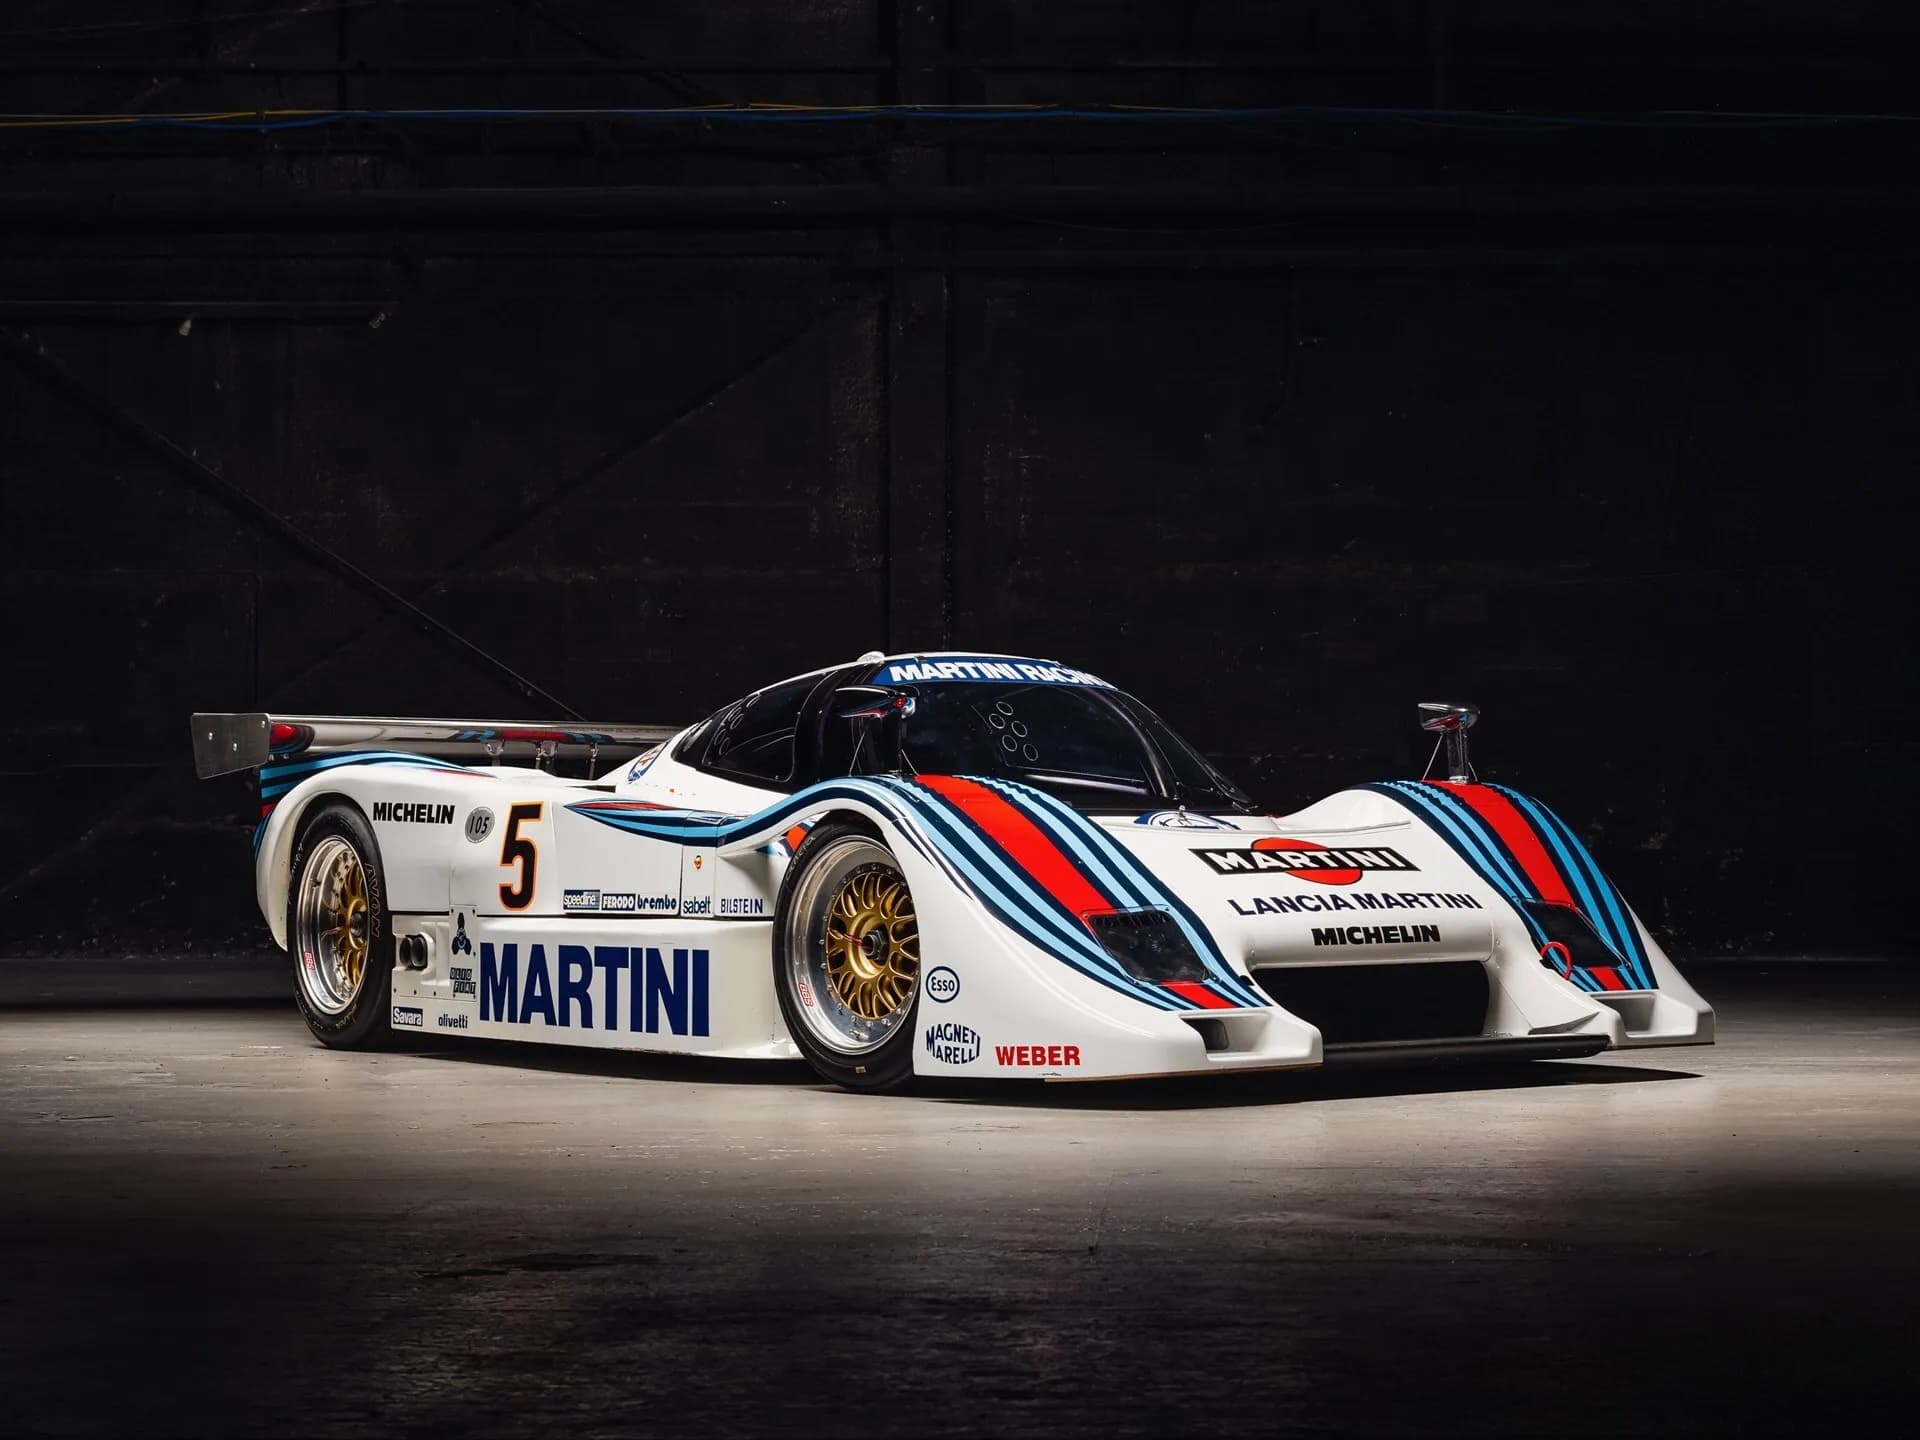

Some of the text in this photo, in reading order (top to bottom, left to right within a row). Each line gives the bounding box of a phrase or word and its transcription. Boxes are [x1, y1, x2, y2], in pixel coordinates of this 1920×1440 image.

[889, 662, 1117, 690] MARTINI RACIN
[373, 802, 455, 824] MICHELIN
[469, 815, 490, 834] 105
[499, 801, 544, 912] 5
[1205, 849, 1407, 871] MARTINI
[364, 862, 380, 938] AVON
[602, 895, 635, 909] FERODO
[637, 894, 677, 910] brembo
[683, 897, 711, 914] sabelt
[720, 898, 763, 914] BILSTEIN
[1228, 892, 1483, 916] LANCIA MARTINI
[1311, 925, 1441, 946] MICHELIN
[453, 981, 476, 994] FIAT
[479, 942, 710, 1037] MARTINI
[393, 1007, 423, 1026] Savara
[438, 1013, 468, 1029] olivetti
[926, 1022, 981, 1051] MAGNETI
[926, 1040, 981, 1065] MARELLI
[995, 1045, 1081, 1066] WEBER
